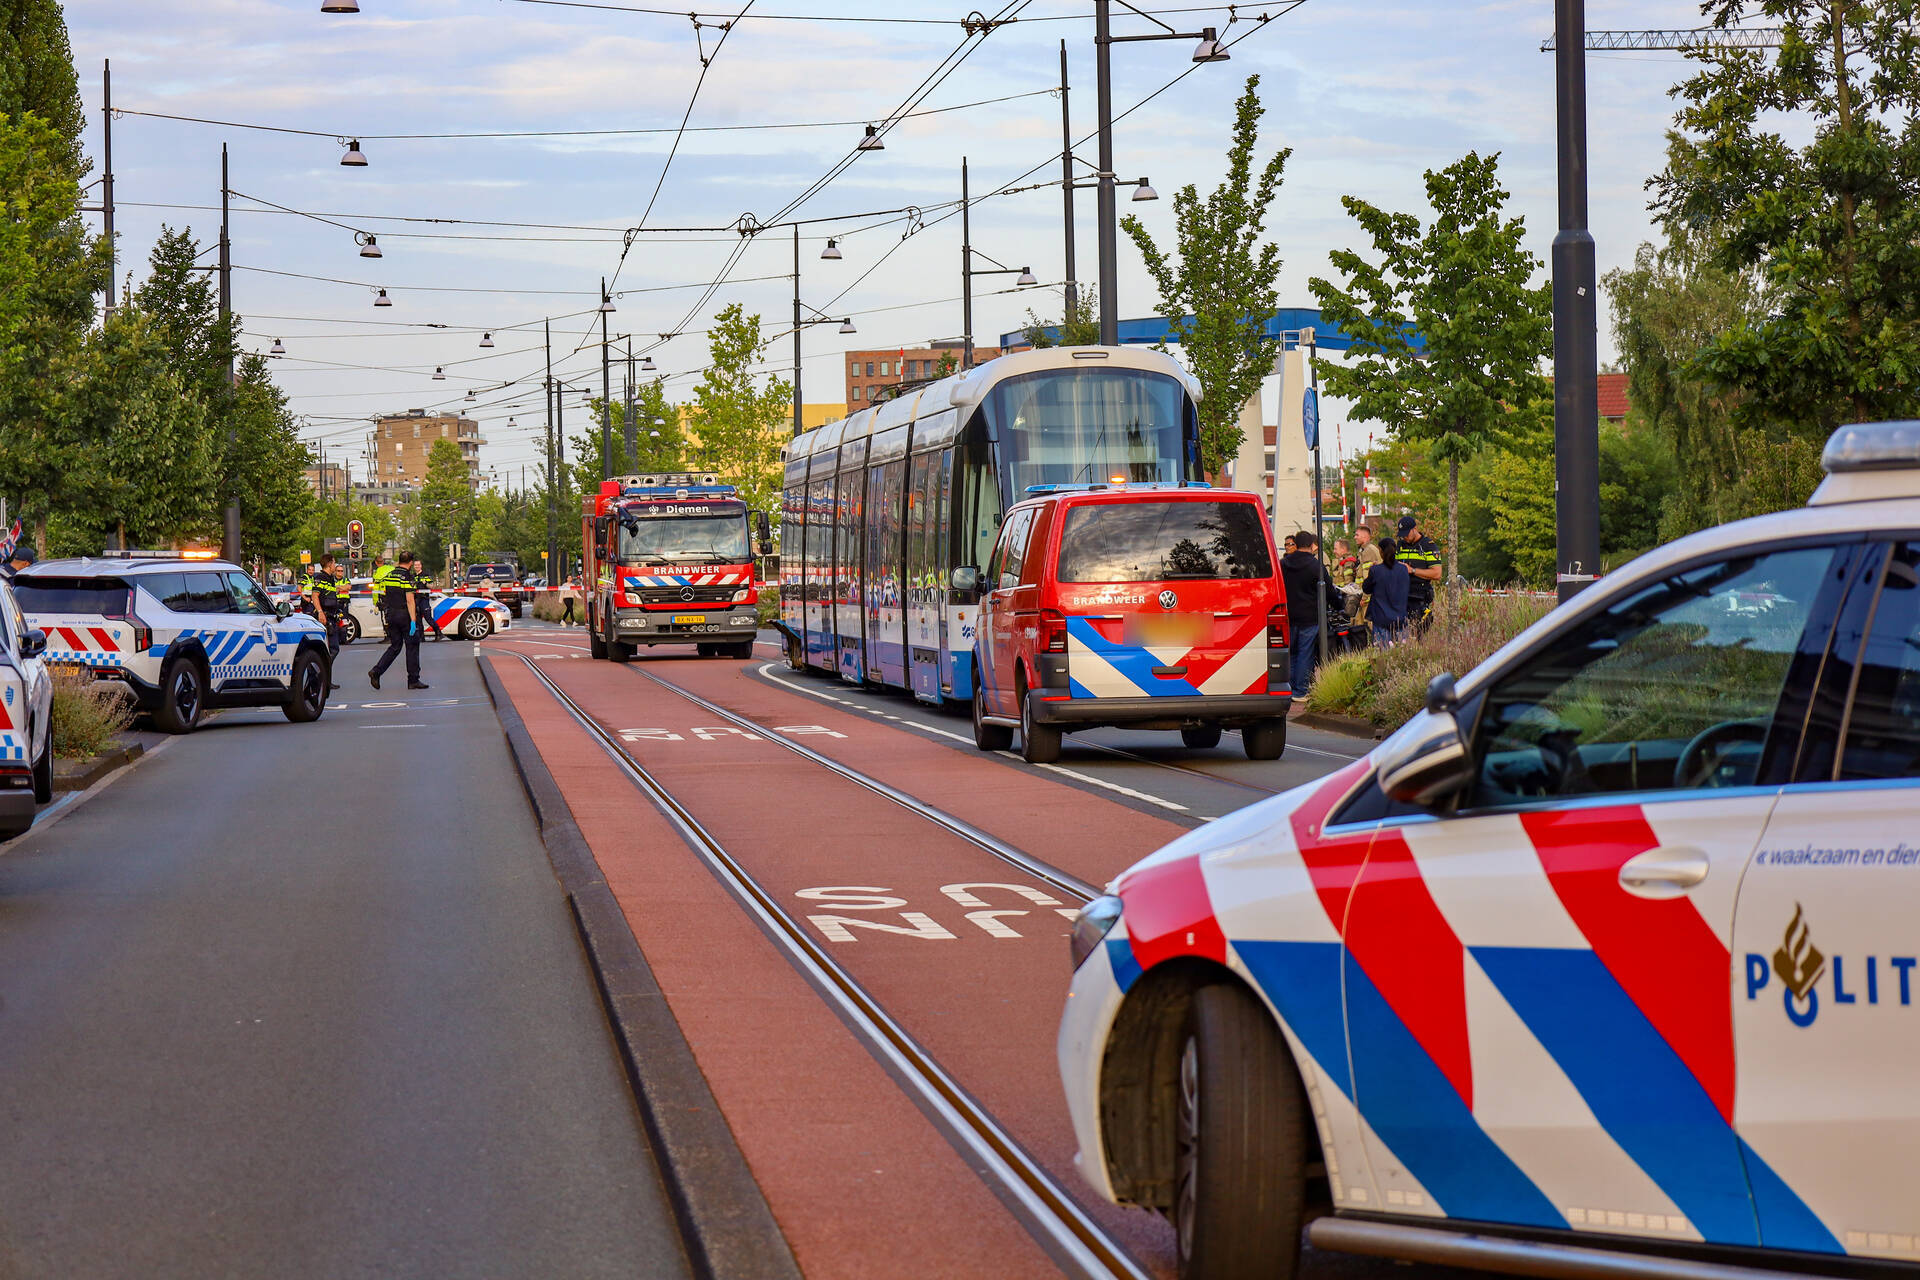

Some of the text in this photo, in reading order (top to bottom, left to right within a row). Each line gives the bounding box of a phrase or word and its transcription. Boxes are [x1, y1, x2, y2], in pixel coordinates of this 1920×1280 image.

[666, 505, 709, 513] Diemen
[653, 565, 720, 575] BRANDWEER
[1073, 595, 1145, 605] BRANDWEER
[1769, 844, 1859, 865] waakzaam
[1861, 849, 1884, 865] en
[1745, 952, 1917, 1028] POLIT
